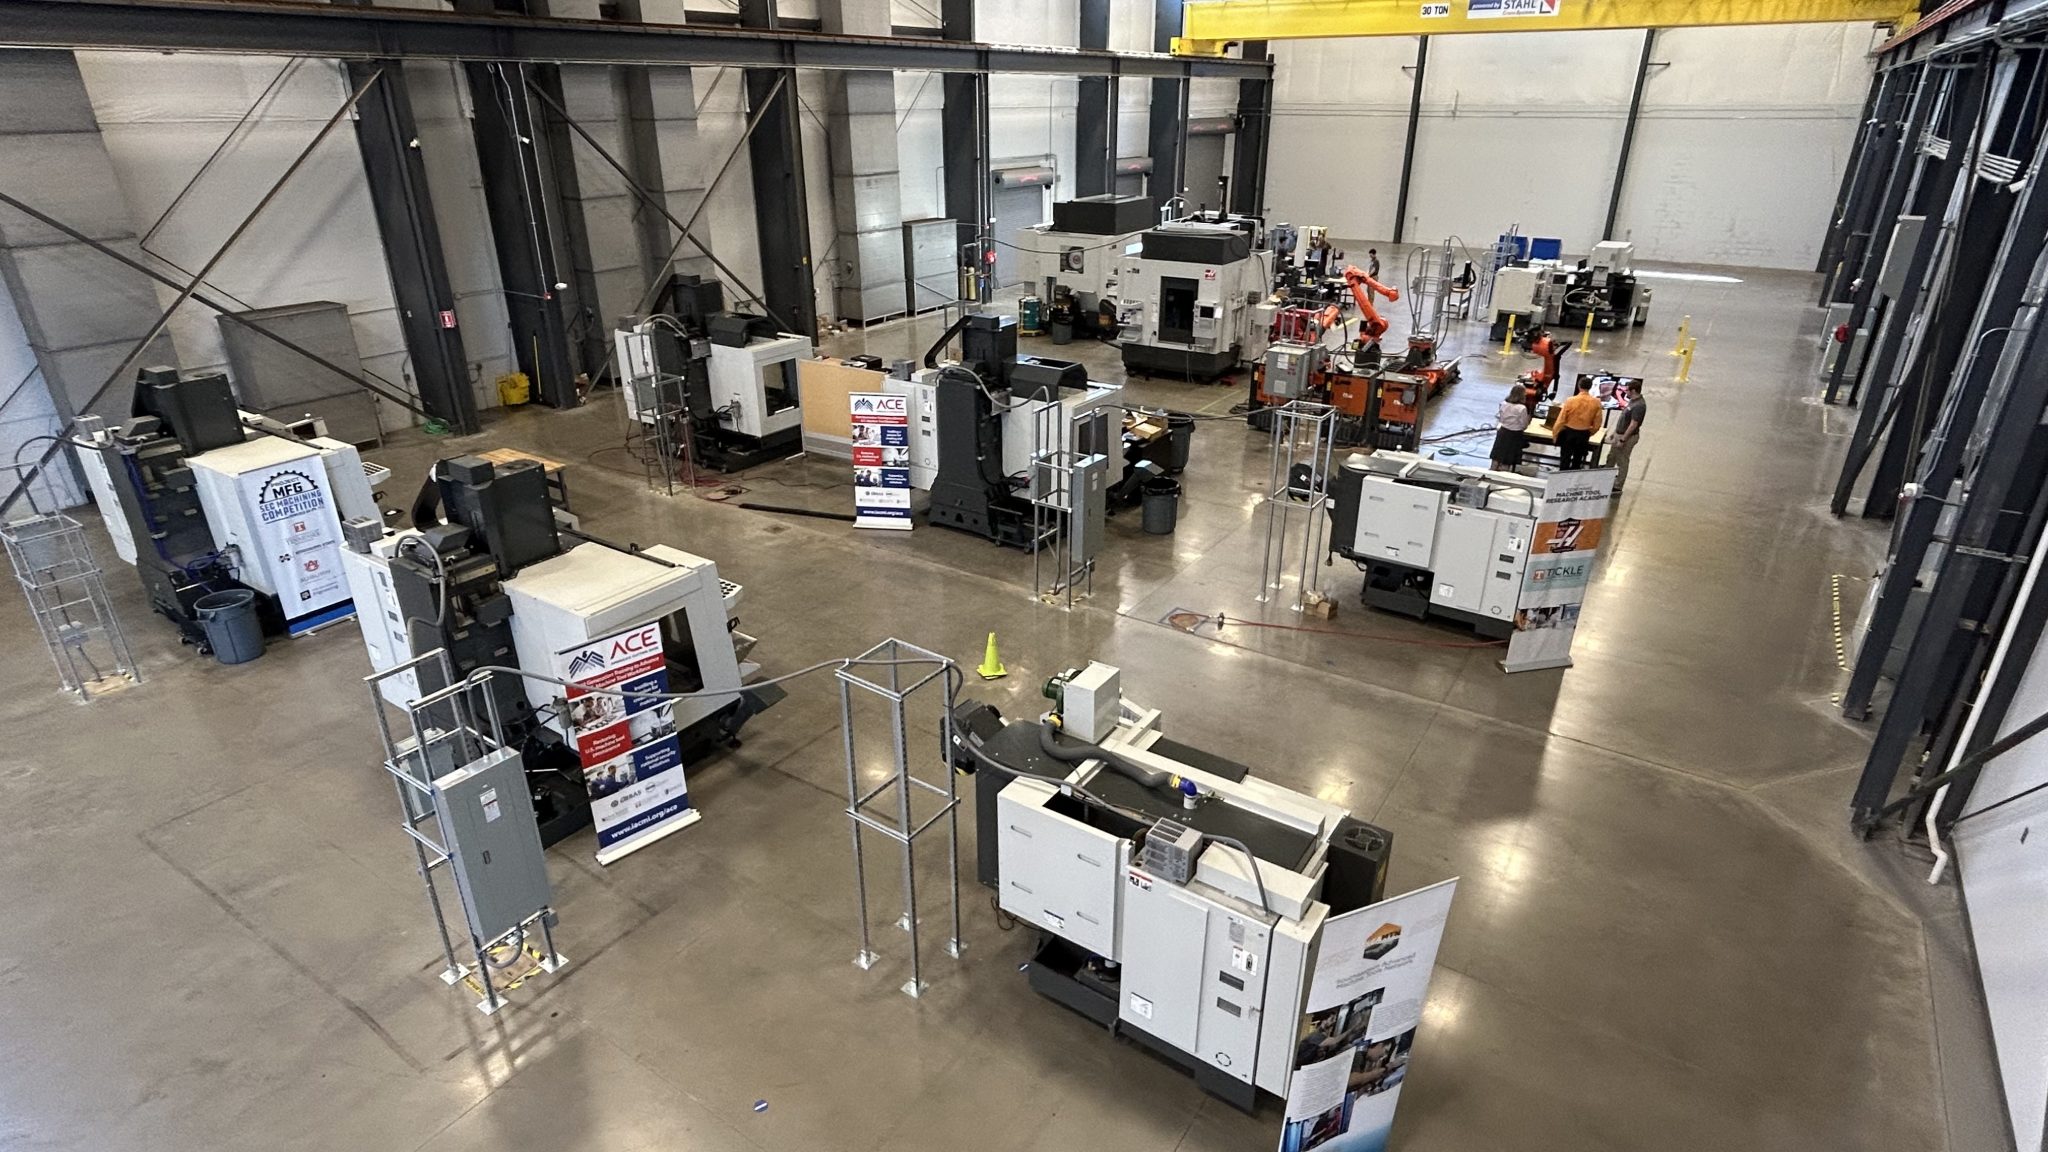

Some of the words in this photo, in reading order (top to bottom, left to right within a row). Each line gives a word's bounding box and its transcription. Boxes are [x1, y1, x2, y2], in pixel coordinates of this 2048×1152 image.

[1422, 6, 1431, 14] 30
[1434, 6, 1448, 14] TON
[1504, 0, 1536, 9] STAHL
[876, 399, 904, 410] ACE
[272, 482, 302, 499] MFG
[260, 502, 276, 512] SEC
[276, 490, 322, 507] MACHINING
[261, 498, 324, 522] COMPETITION
[1546, 565, 1584, 576] TICKLE
[610, 627, 658, 660] ACE
